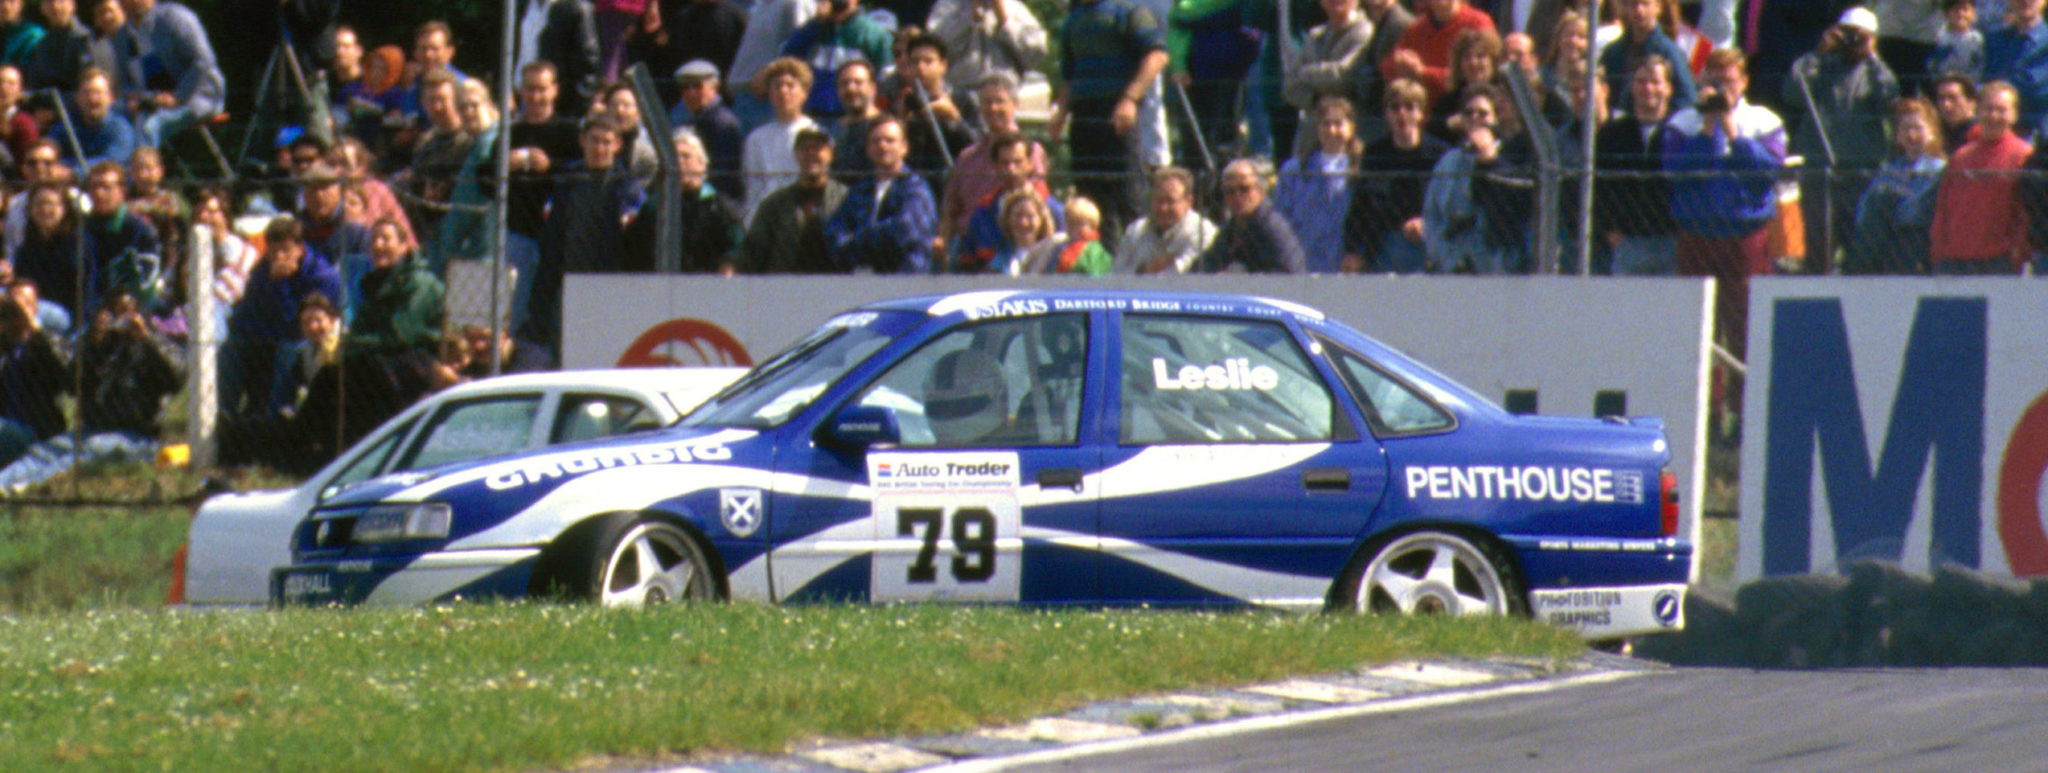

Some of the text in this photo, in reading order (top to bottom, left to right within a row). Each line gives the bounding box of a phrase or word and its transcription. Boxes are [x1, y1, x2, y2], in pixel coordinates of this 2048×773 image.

[981, 298, 1049, 317] STAKIS
[1054, 299, 1127, 310] DARTFORD
[1132, 299, 1182, 311] BRIDGE
[1152, 357, 1279, 391] Leslie
[485, 441, 733, 490] GRUNDIG
[895, 461, 1011, 477] Auto Trader
[920, 480, 946, 489] Touring
[1405, 465, 1615, 503] PENTHOUSE
[896, 505, 997, 584] 79
[1550, 609, 1612, 626] GRAPHICS
